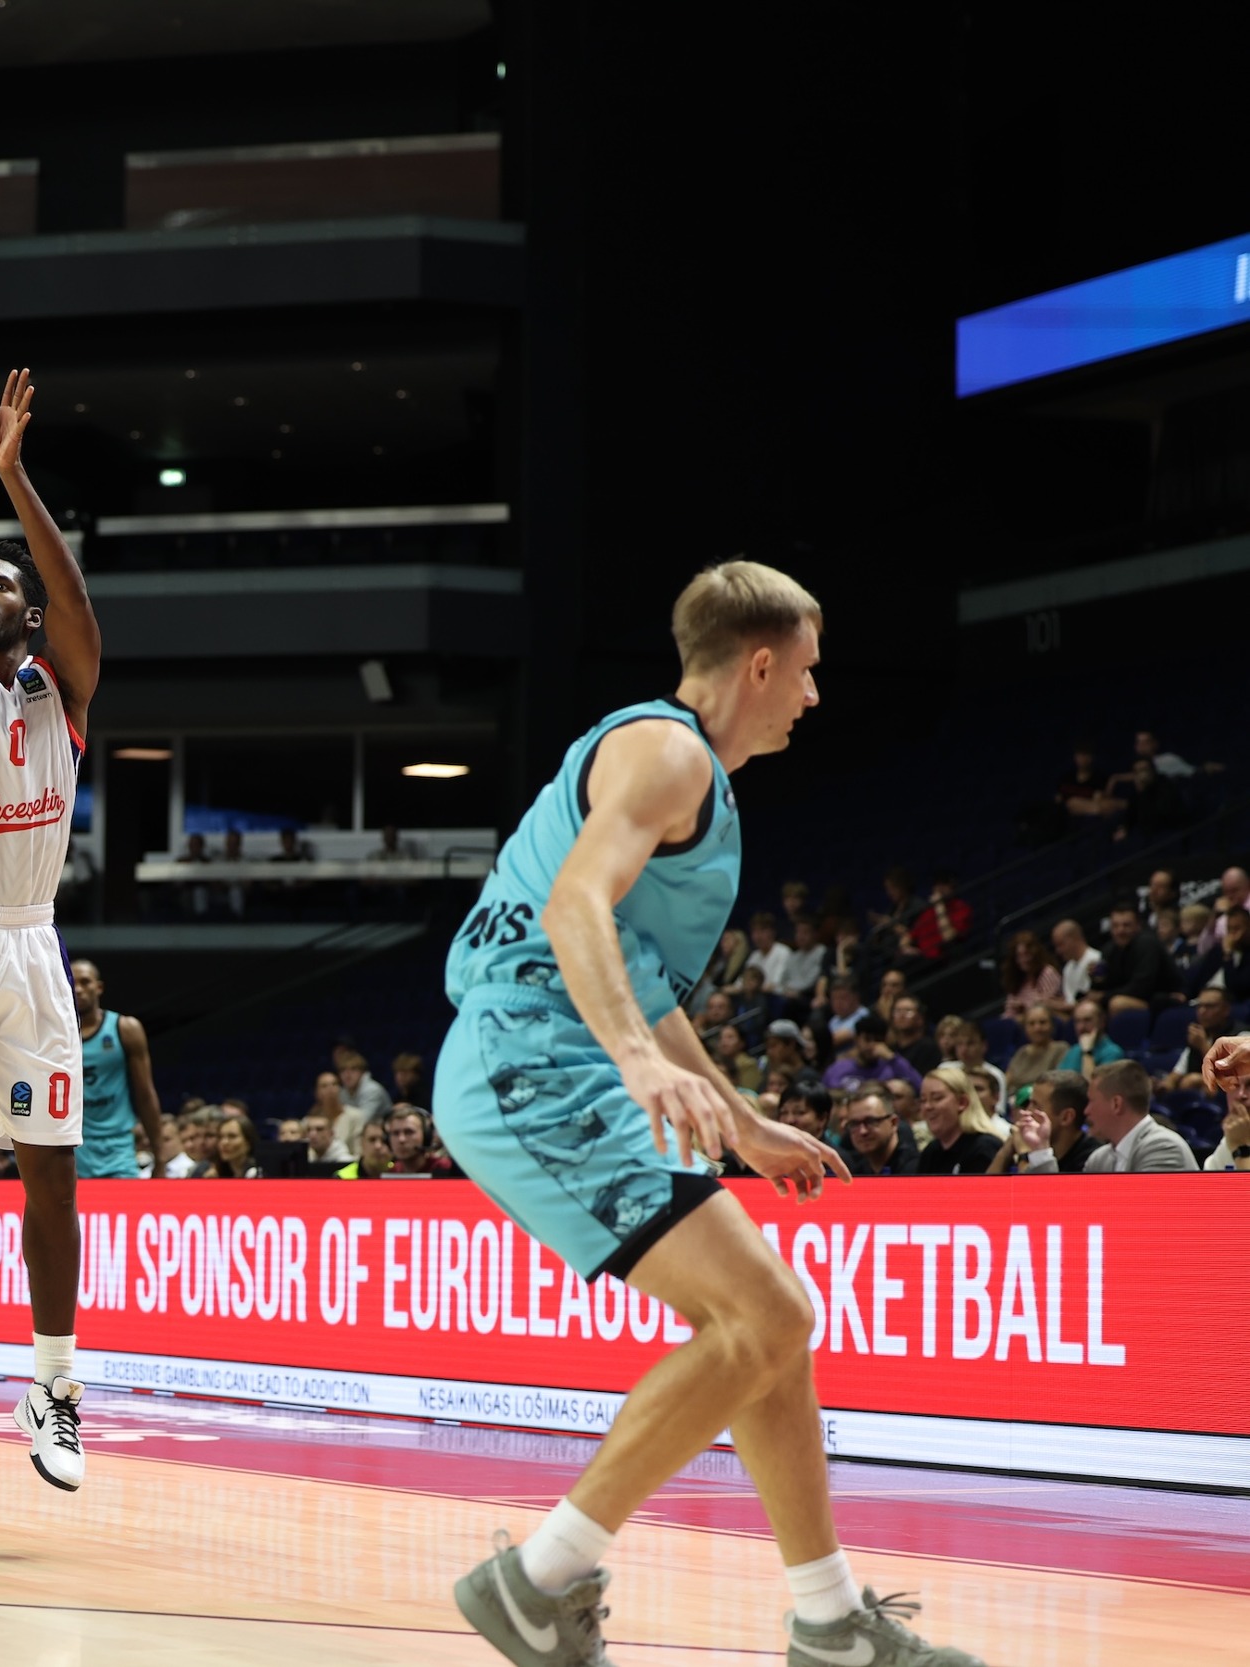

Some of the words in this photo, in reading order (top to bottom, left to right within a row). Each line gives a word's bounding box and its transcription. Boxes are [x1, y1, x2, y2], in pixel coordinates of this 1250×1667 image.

[9, 718, 26, 767] 0
[48, 1072, 71, 1120] 0
[135, 1213, 307, 1323] SPONSOR
[319, 1217, 372, 1326] OF
[760, 1222, 1127, 1367] SKETBALL
[103, 1360, 161, 1384] EXCESSIVE
[164, 1365, 222, 1389] GAMBLING
[225, 1371, 249, 1392] CAN
[251, 1375, 281, 1396] LEAD
[285, 1377, 300, 1397] TO
[303, 1379, 370, 1403] ADDICTION
[420, 1387, 511, 1417] NESAIKINGAS
[515, 1392, 579, 1423] LOŠIMAS
